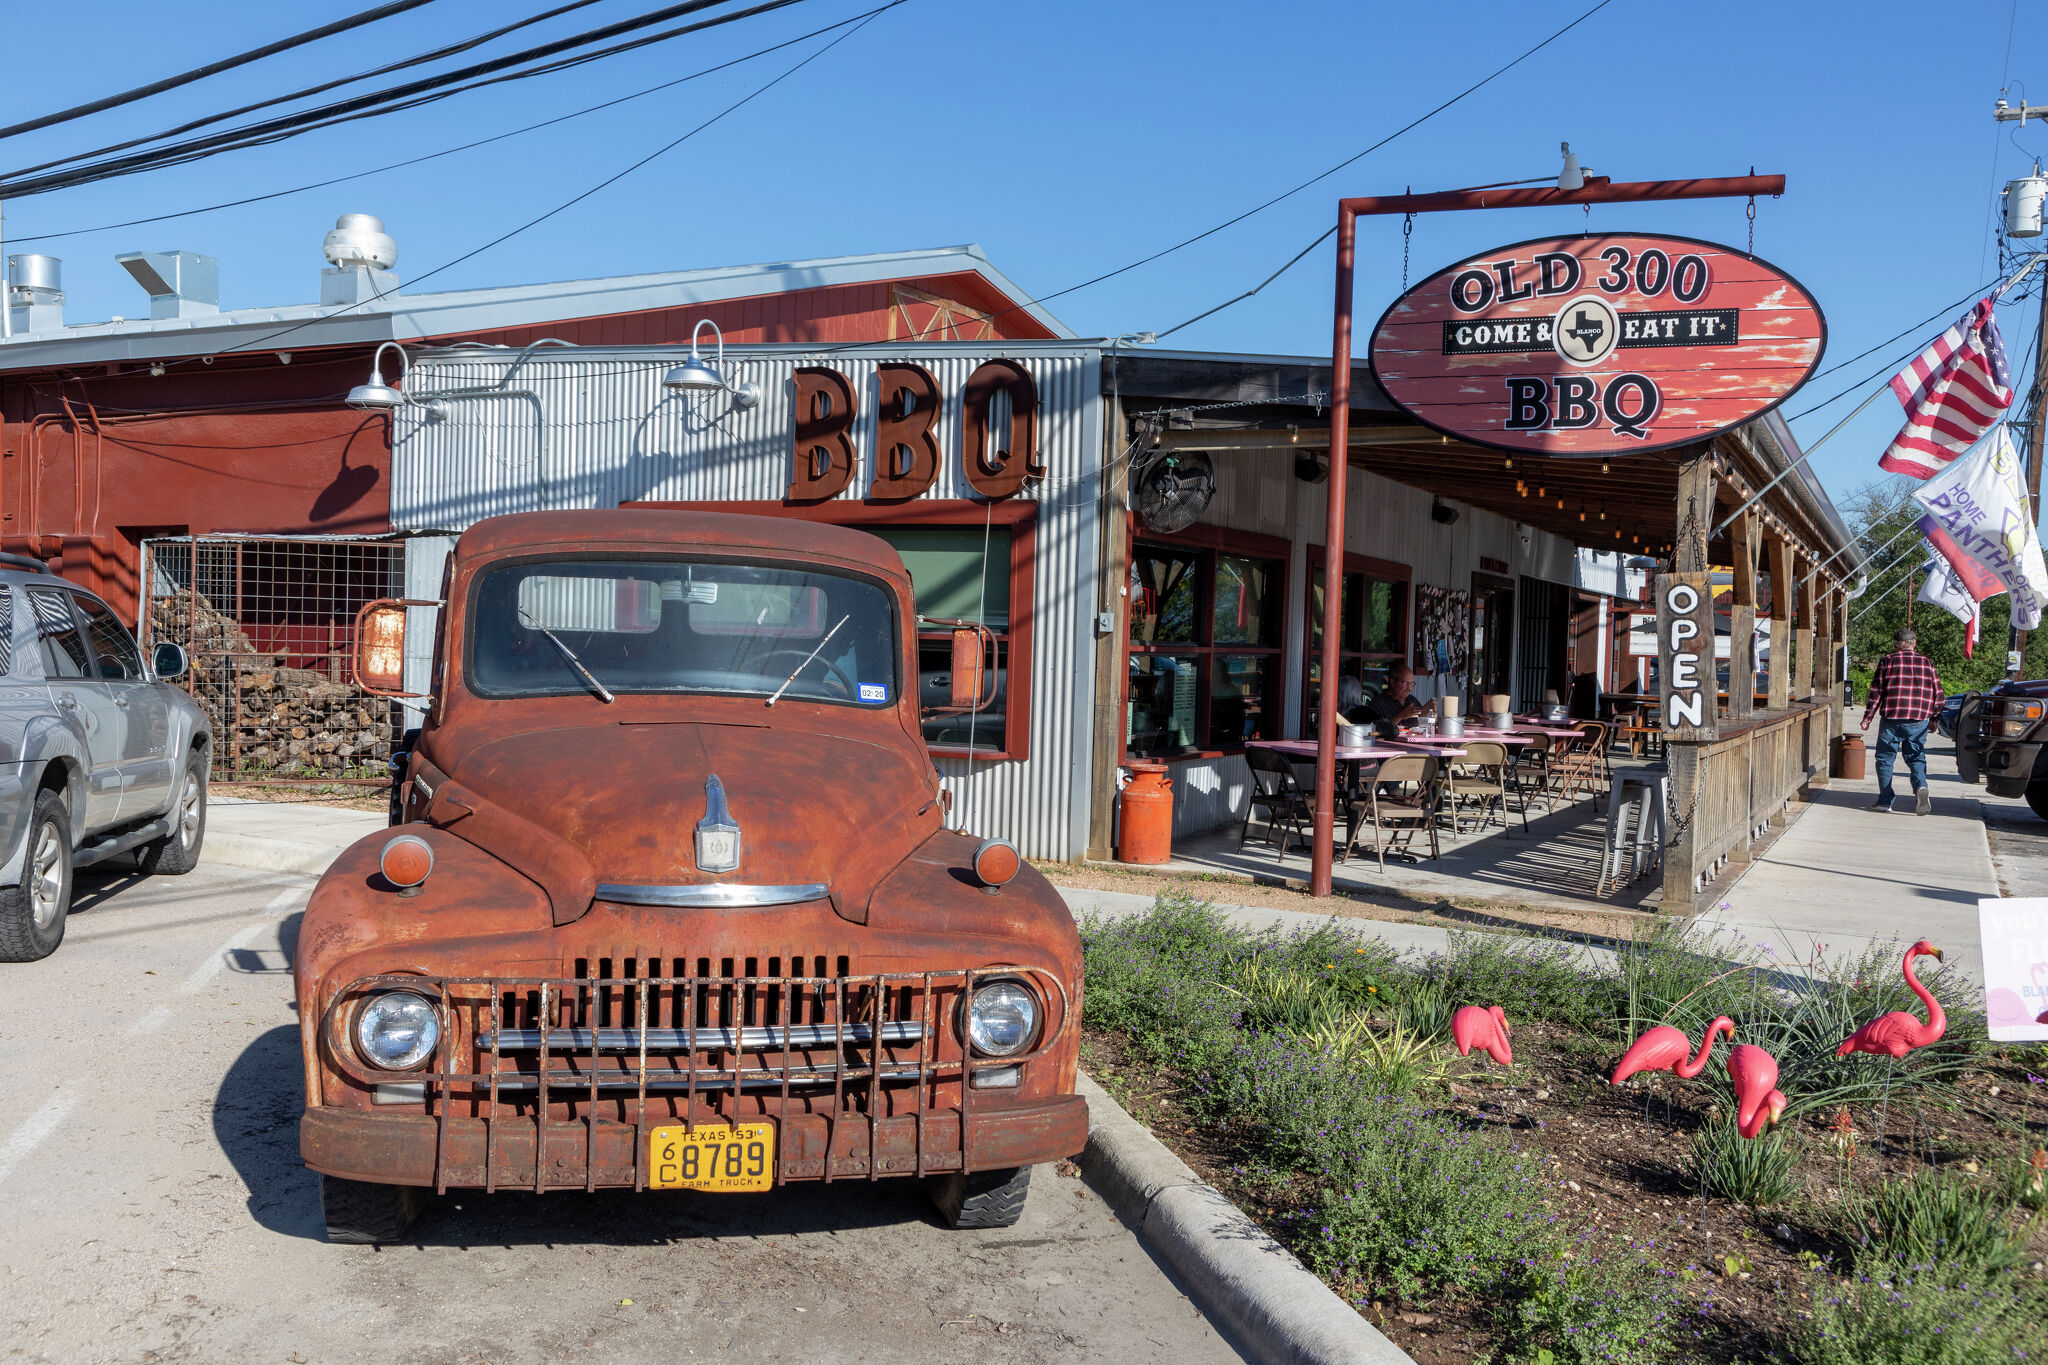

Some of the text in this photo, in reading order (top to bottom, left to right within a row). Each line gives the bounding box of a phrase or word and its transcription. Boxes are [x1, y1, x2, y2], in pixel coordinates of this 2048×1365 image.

[1450, 246, 1709, 314] OLD 300
[1455, 317, 1721, 346] COME & EAT IT
[788, 358, 1047, 500] BBQ
[1504, 373, 1661, 440] BBQ
[1928, 492, 2028, 625] PANTHERS
[1949, 482, 1987, 525] HOME
[2015, 575, 2031, 592] OF
[1666, 583, 1704, 730] OPEN
[662, 1142, 676, 1160] 6
[681, 1131, 726, 1141] TEXAS
[682, 1142, 765, 1180] 8789
[659, 1164, 677, 1182] C
[682, 1178, 753, 1188] FARM TRUCK
